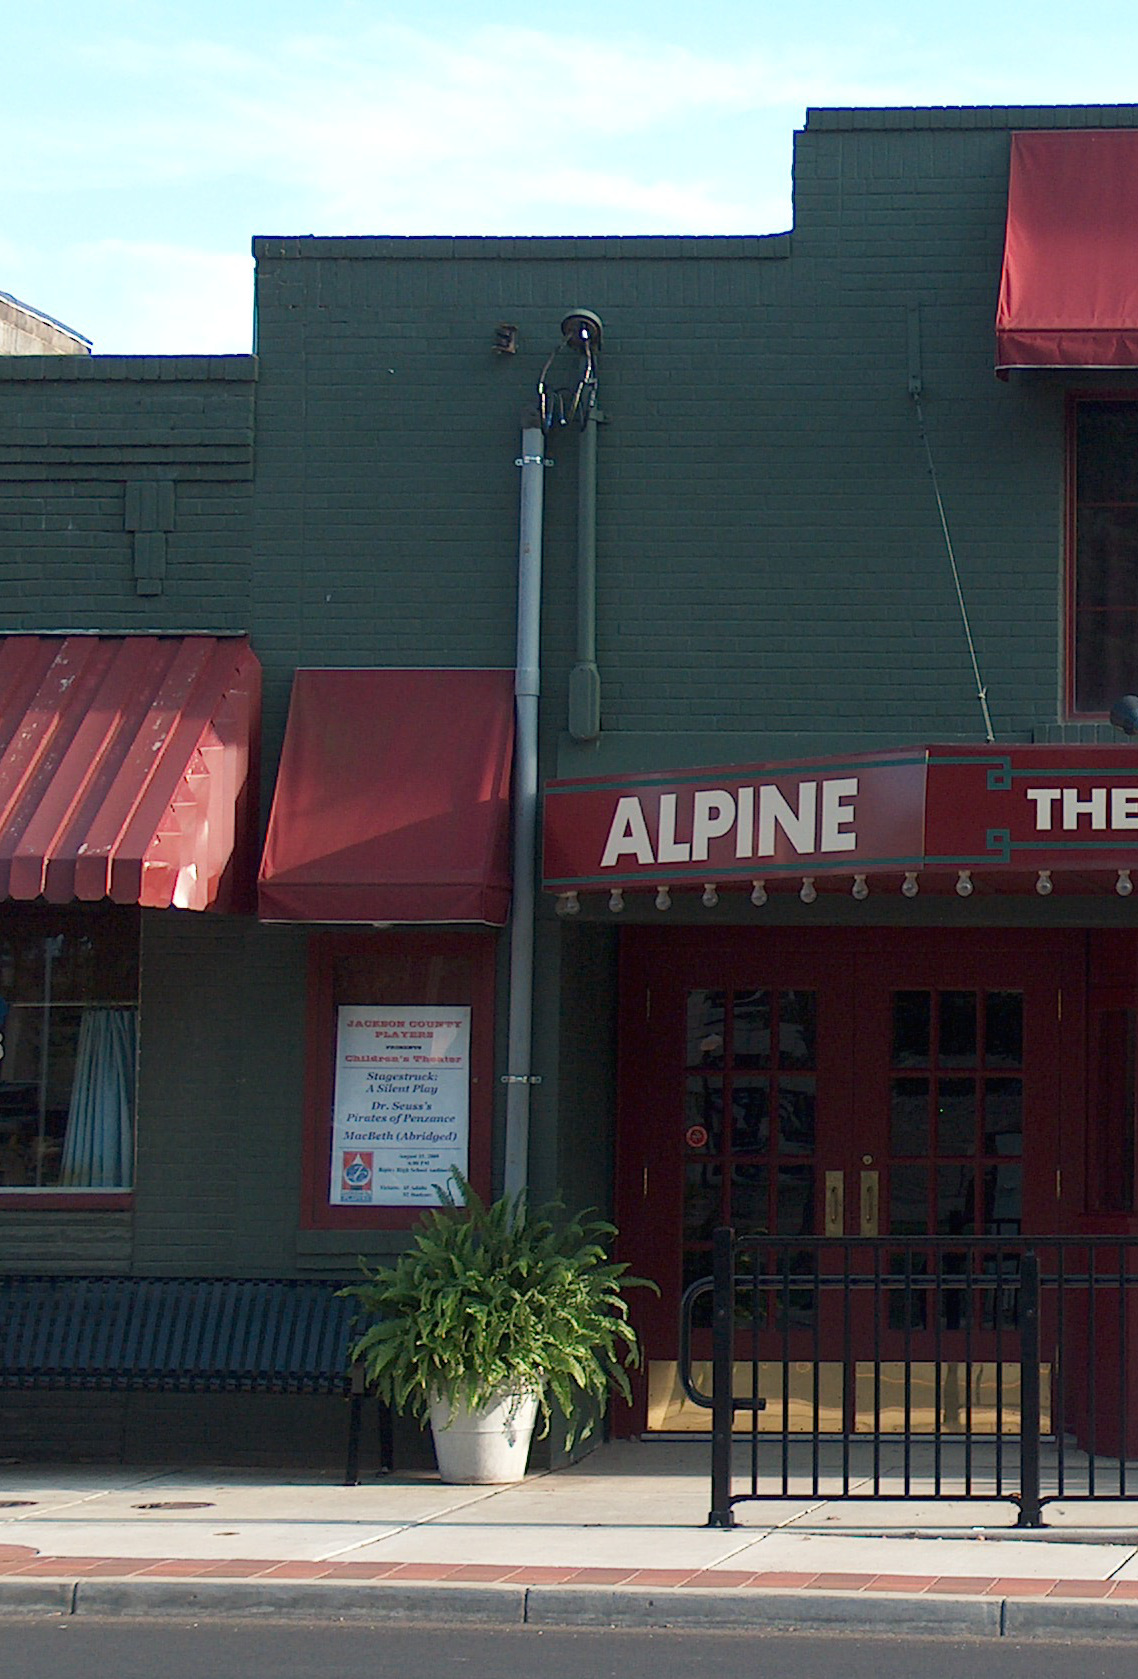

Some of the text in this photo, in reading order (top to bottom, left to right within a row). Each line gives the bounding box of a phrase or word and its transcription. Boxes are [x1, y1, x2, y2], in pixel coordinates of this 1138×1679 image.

[600, 778, 858, 867] ALPINE
[346, 1020, 463, 1029] JACKSON COUNTY
[375, 1031, 434, 1039] PLAYERS
[366, 1072, 439, 1082] Stagestruck:
[365, 1084, 439, 1095] A Silent Play
[371, 1101, 433, 1111] Dr. Seuss's
[346, 1113, 457, 1125] Pirates of Penzance
[343, 1131, 458, 1143] MacBeth (Abridged)
